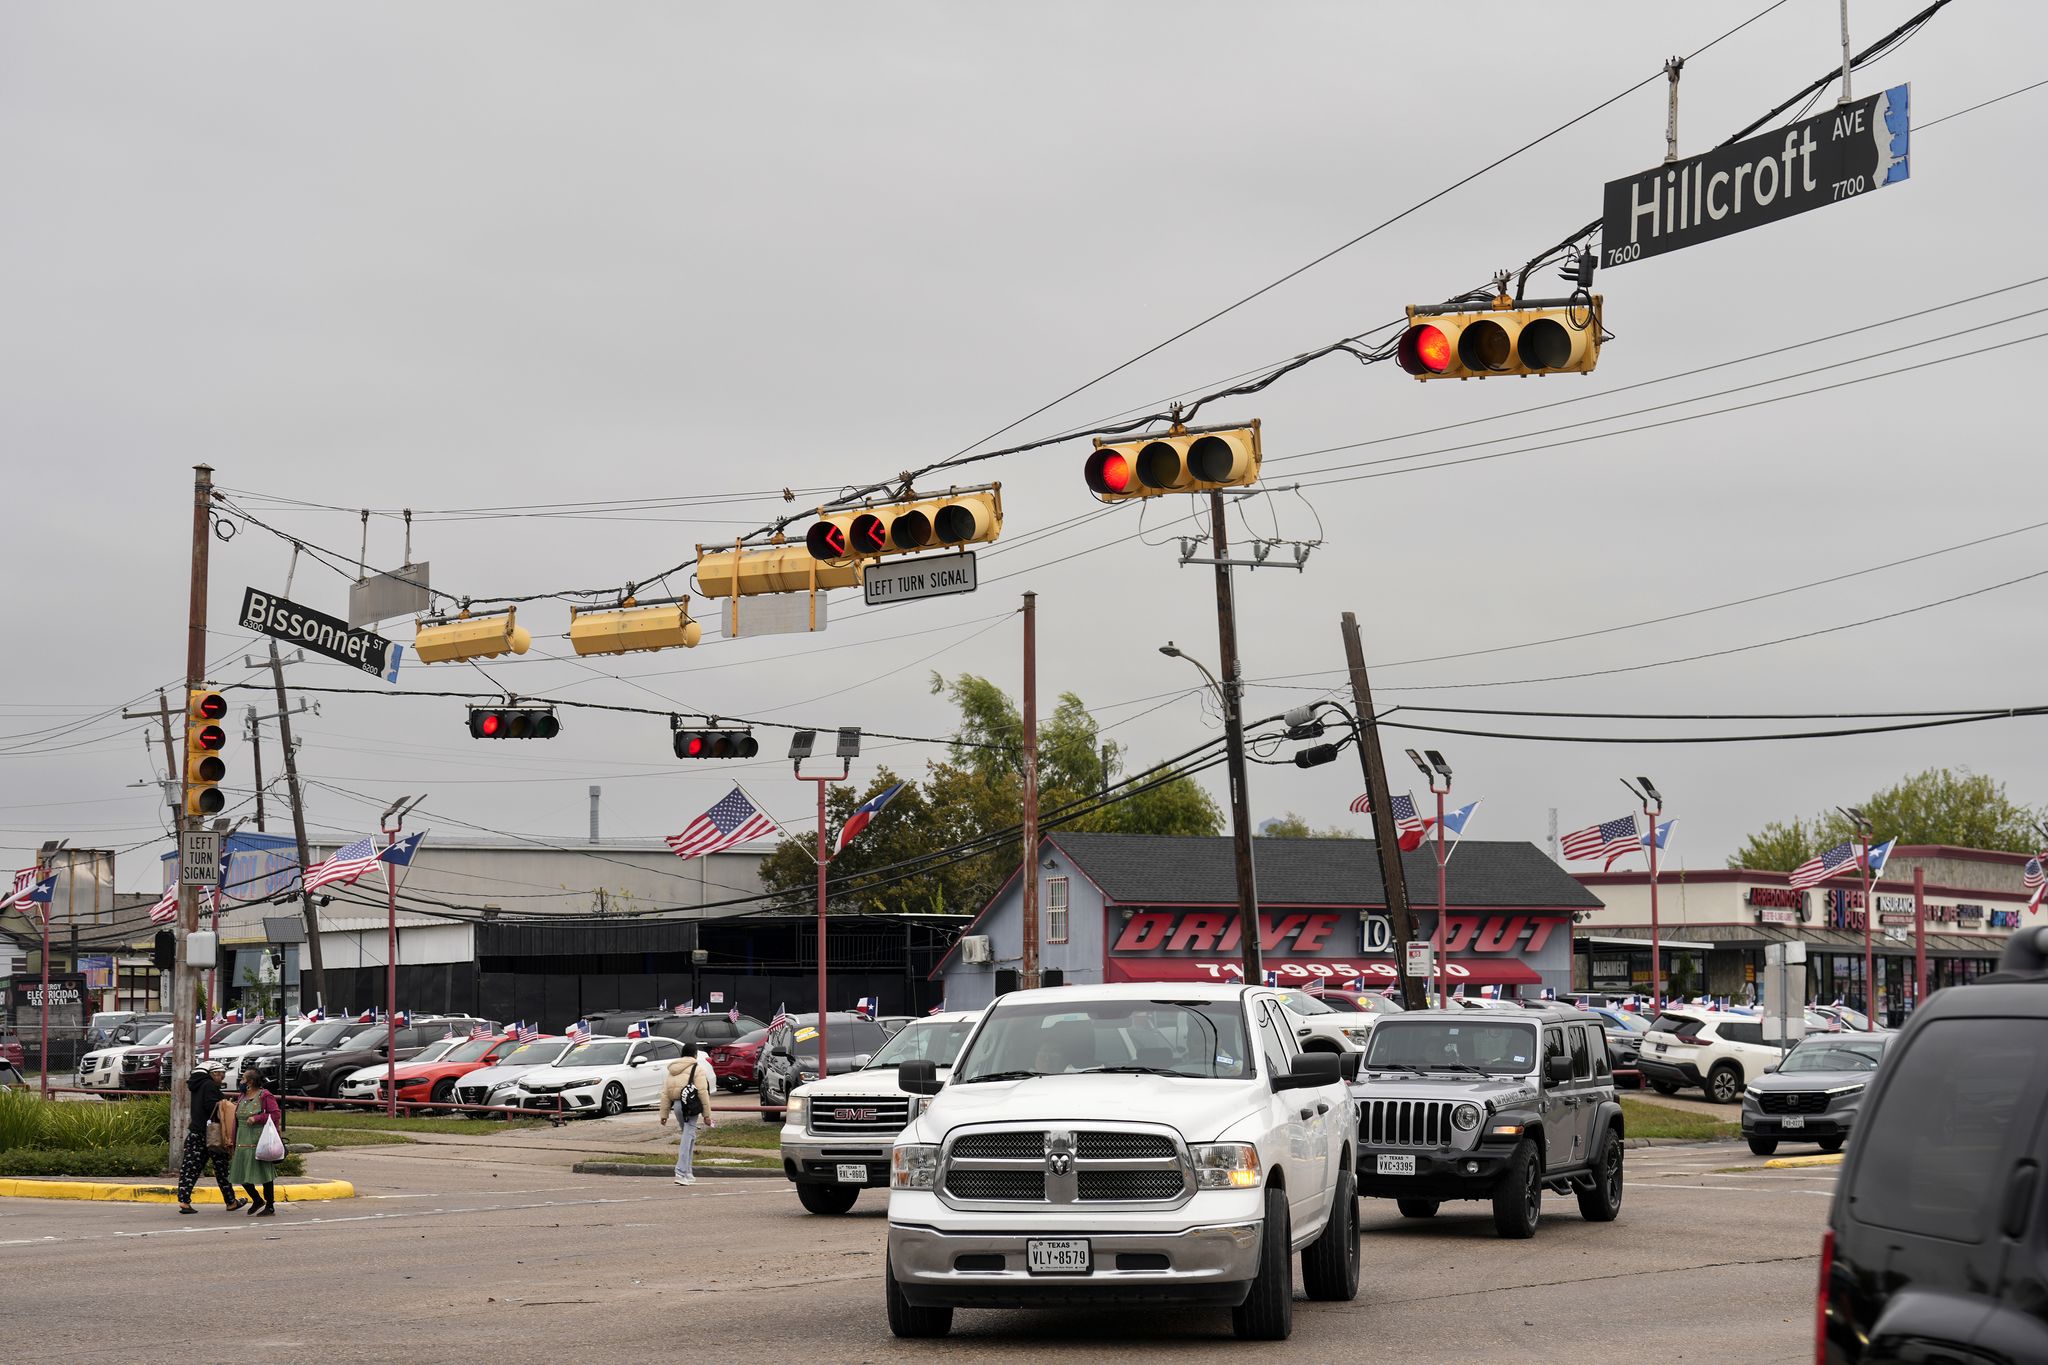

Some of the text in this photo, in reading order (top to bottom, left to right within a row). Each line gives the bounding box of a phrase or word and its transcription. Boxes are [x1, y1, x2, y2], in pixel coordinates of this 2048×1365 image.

[1832, 109, 1865, 141] AVE
[1630, 125, 1817, 243] Hillcroft
[1832, 175, 1865, 201] 7700
[1608, 243, 1641, 265] 7600
[869, 569, 969, 597] LEFT TURN SIGNAL
[242, 619, 264, 632] 6300
[247, 593, 370, 663] Bissonnet
[373, 639, 384, 651] ST
[362, 662, 378, 675] 6200
[190, 837, 212, 850] LEFT
[190, 852, 213, 865] TURN
[184, 866, 217, 880] SIGNAL
[1831, 888, 1864, 909] SUPER
[1879, 896, 1915, 912] INSURANC
[1114, 912, 1341, 951] DRIVE
[1430, 915, 1569, 952] OUT
[1593, 961, 1629, 977] ALIGNMENT
[27, 990, 79, 1000] ELECRICIDAD
[834, 1108, 877, 1121] GMC
